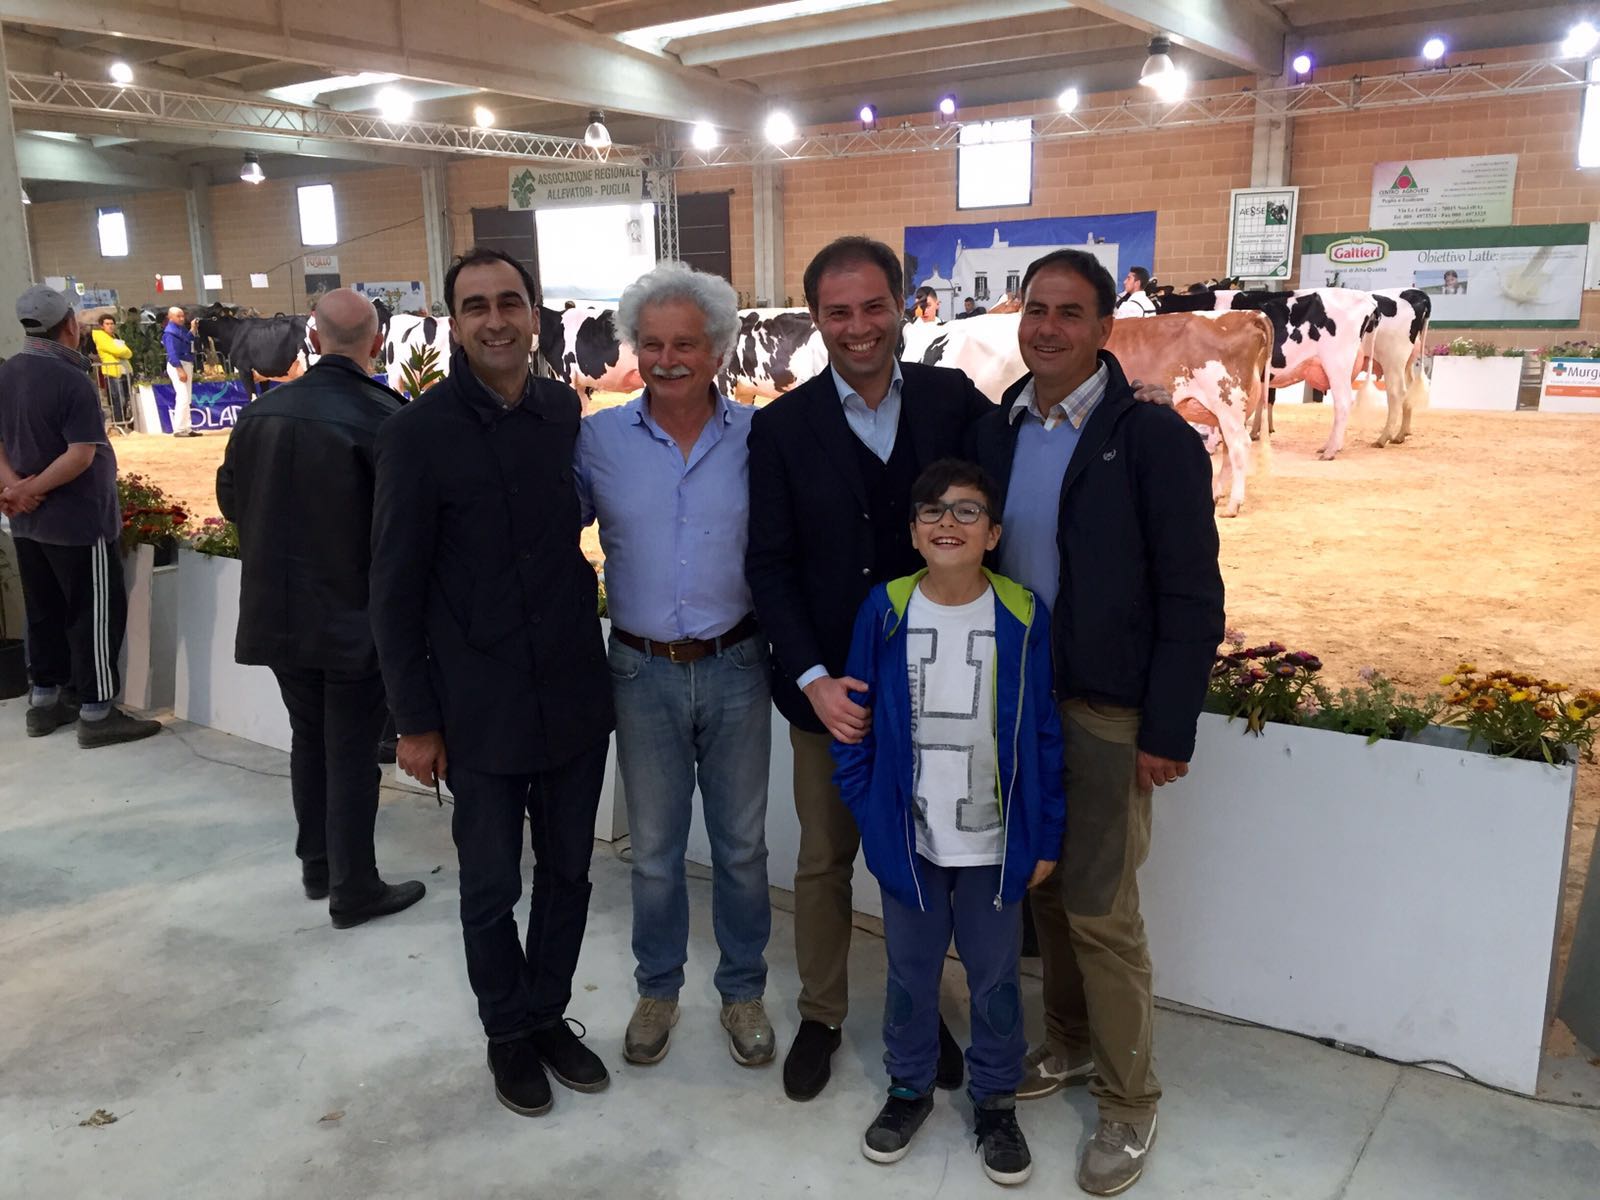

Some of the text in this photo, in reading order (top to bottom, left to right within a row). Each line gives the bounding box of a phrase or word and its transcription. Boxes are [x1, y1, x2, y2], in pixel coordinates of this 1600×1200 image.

[537, 166, 641, 185] ASSOCIAZIONE REGIONALE
[547, 185, 593, 200] ALLEVATORI
[600, 182, 630, 197] PUGLIA
[1333, 246, 1381, 260] Galtieri
[1417, 249, 1466, 264] Obiettivo
